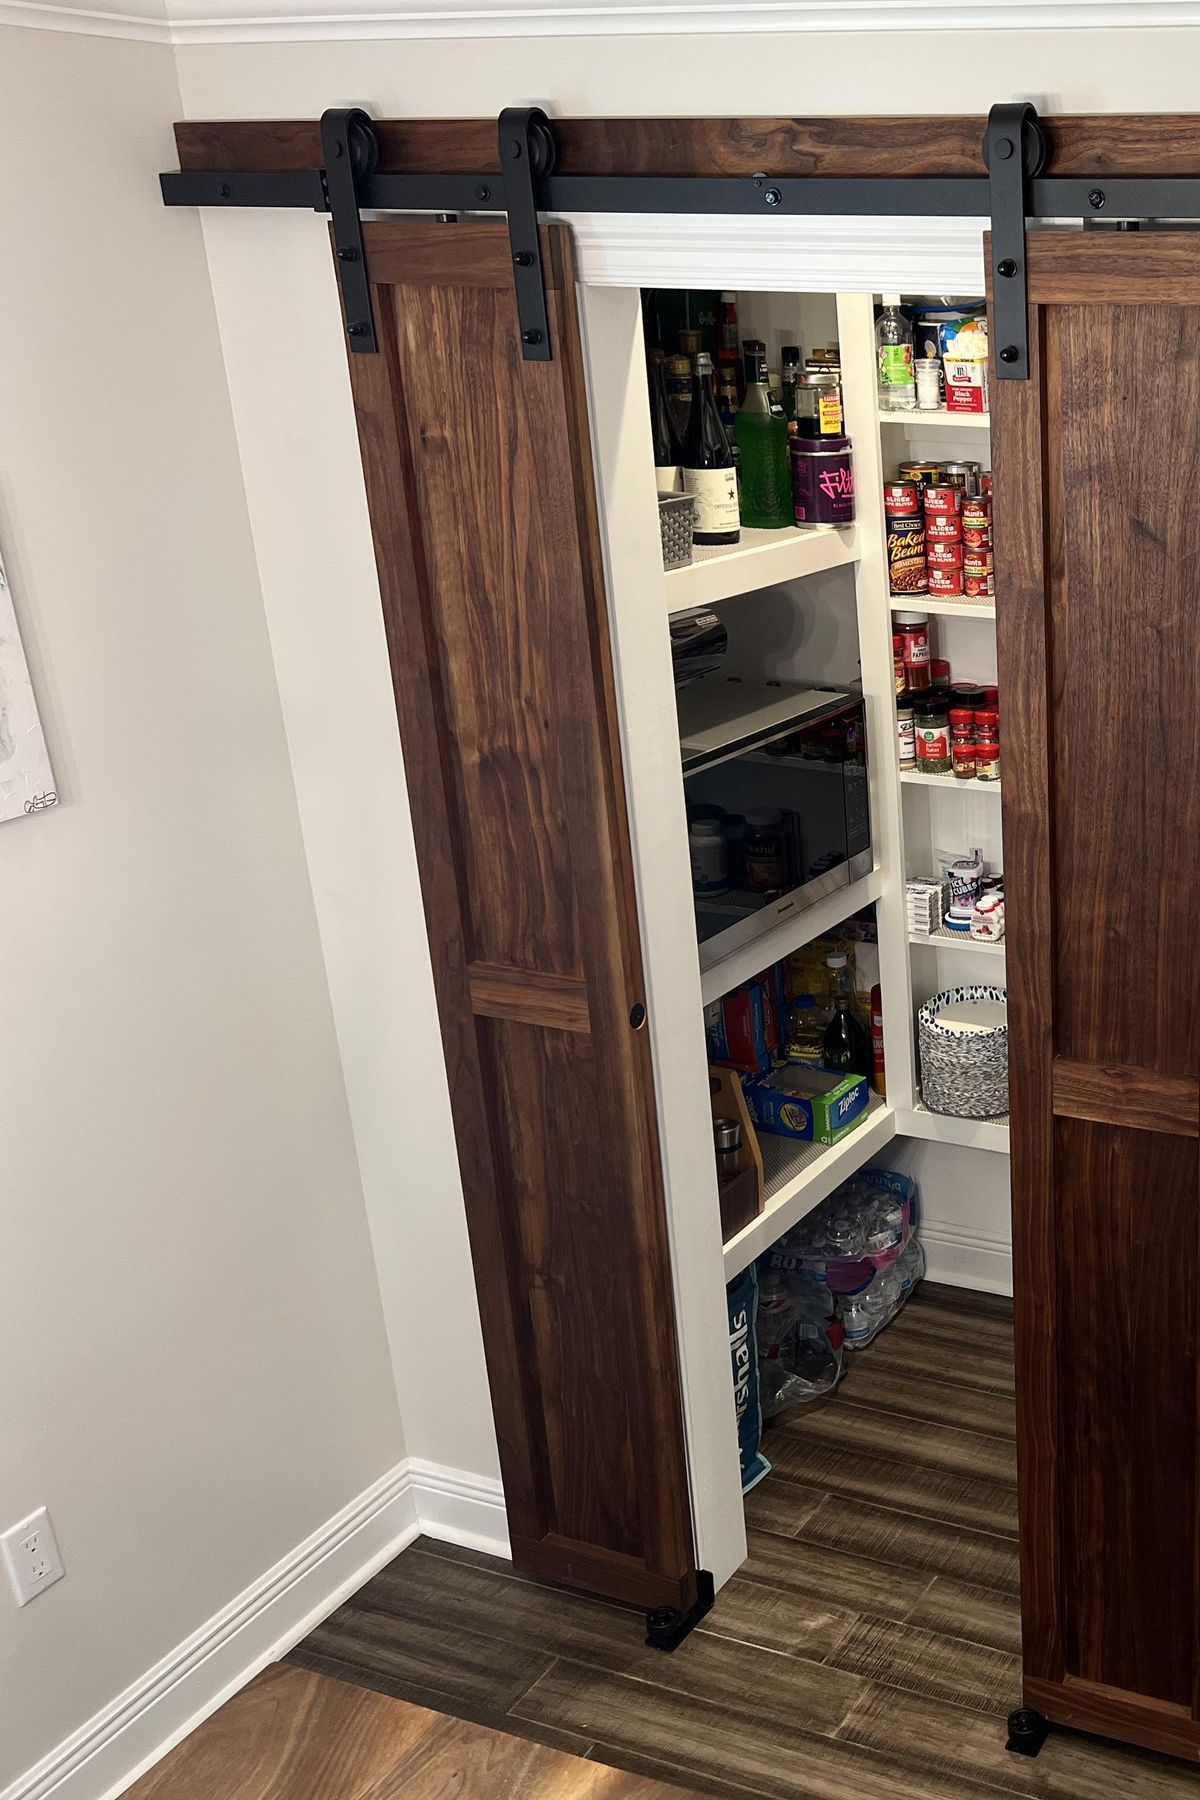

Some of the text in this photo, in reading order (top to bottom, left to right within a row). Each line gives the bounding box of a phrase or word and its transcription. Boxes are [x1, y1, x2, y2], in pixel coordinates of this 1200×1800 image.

[888, 531, 926, 547] Baked
[891, 543, 924, 561] Beans
[952, 878, 964, 888] ICE
[953, 881, 978, 896] CUBES
[838, 1087, 860, 1117] Ziploc
